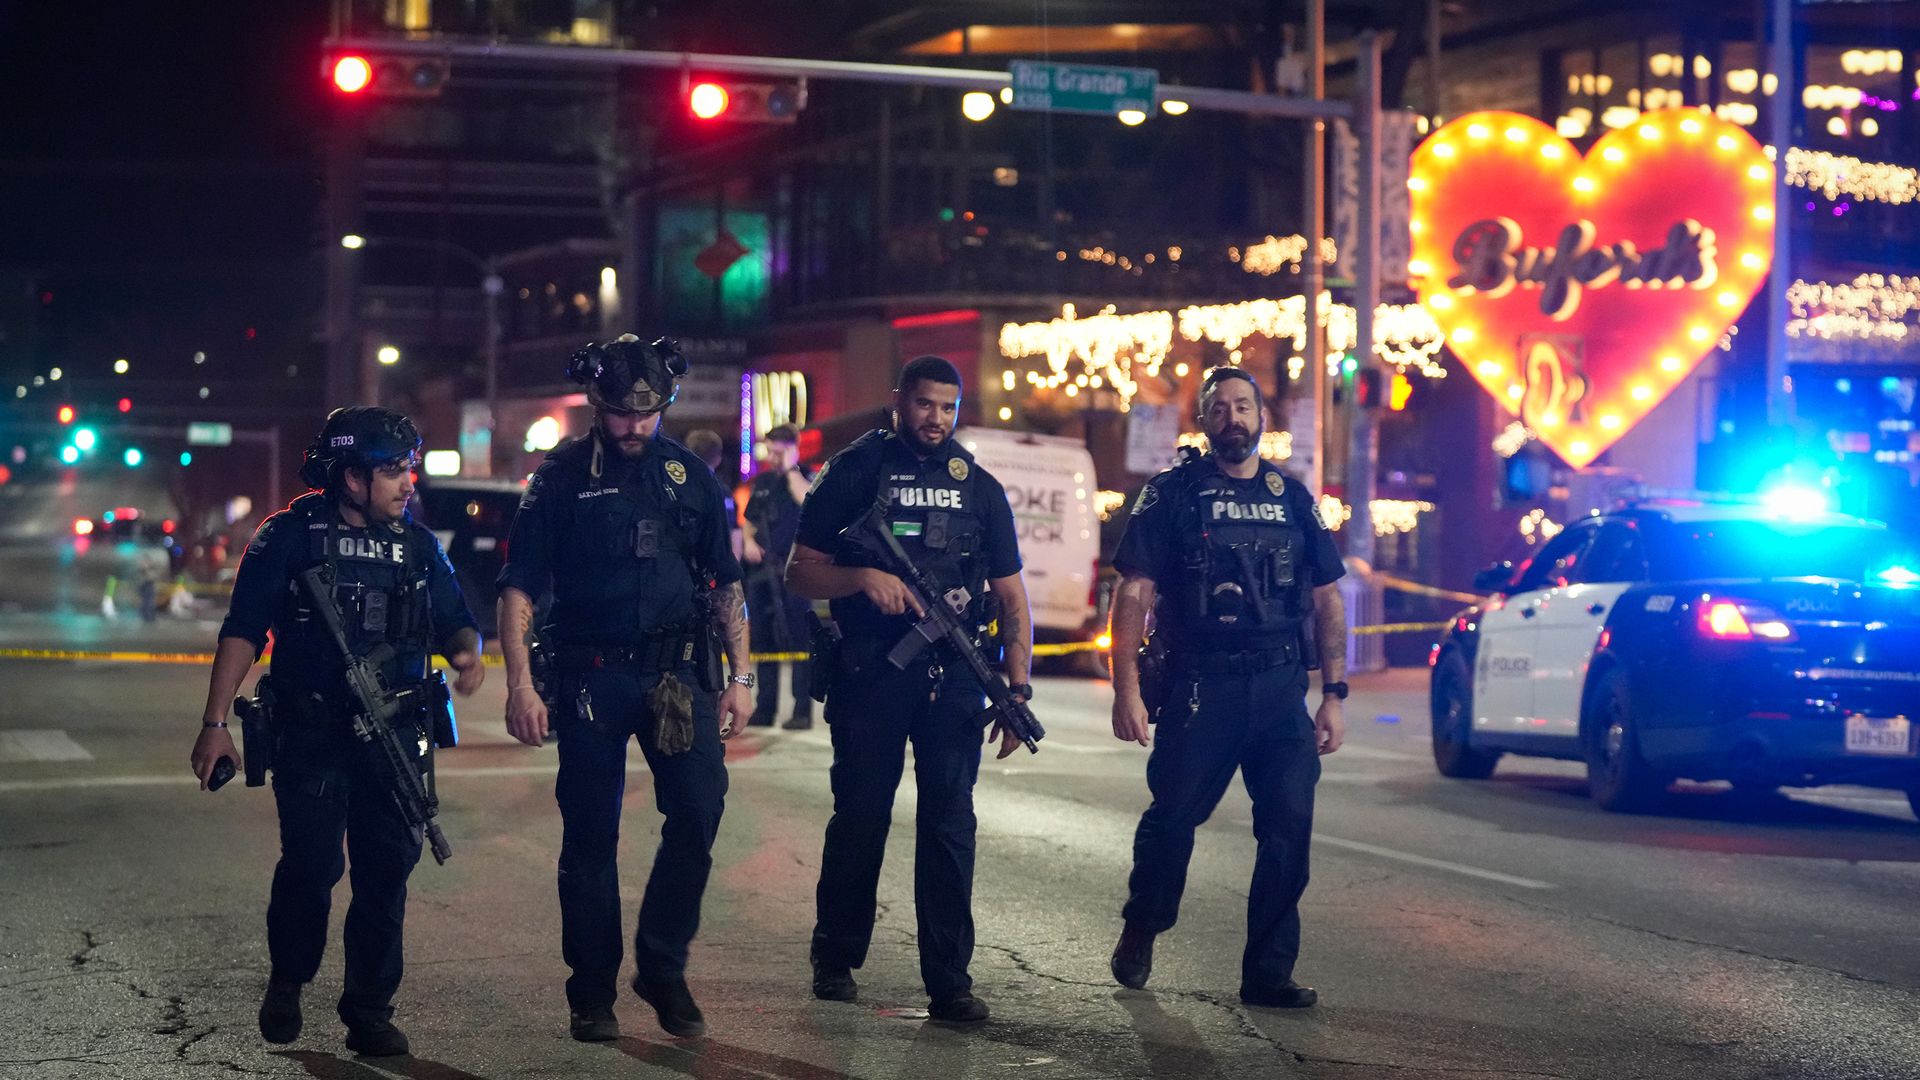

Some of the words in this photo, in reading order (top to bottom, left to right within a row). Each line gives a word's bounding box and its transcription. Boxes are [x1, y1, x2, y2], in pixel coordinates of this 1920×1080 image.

[1018, 64, 1049, 88] Rio
[1055, 67, 1126, 94] Grande
[1448, 216, 1718, 322] Buford's
[331, 435, 355, 447] E703
[888, 487, 962, 509] POLICE
[1004, 485, 1067, 513] OKE
[1212, 501, 1286, 522] POLICE
[1492, 656, 1531, 672] POLICE
